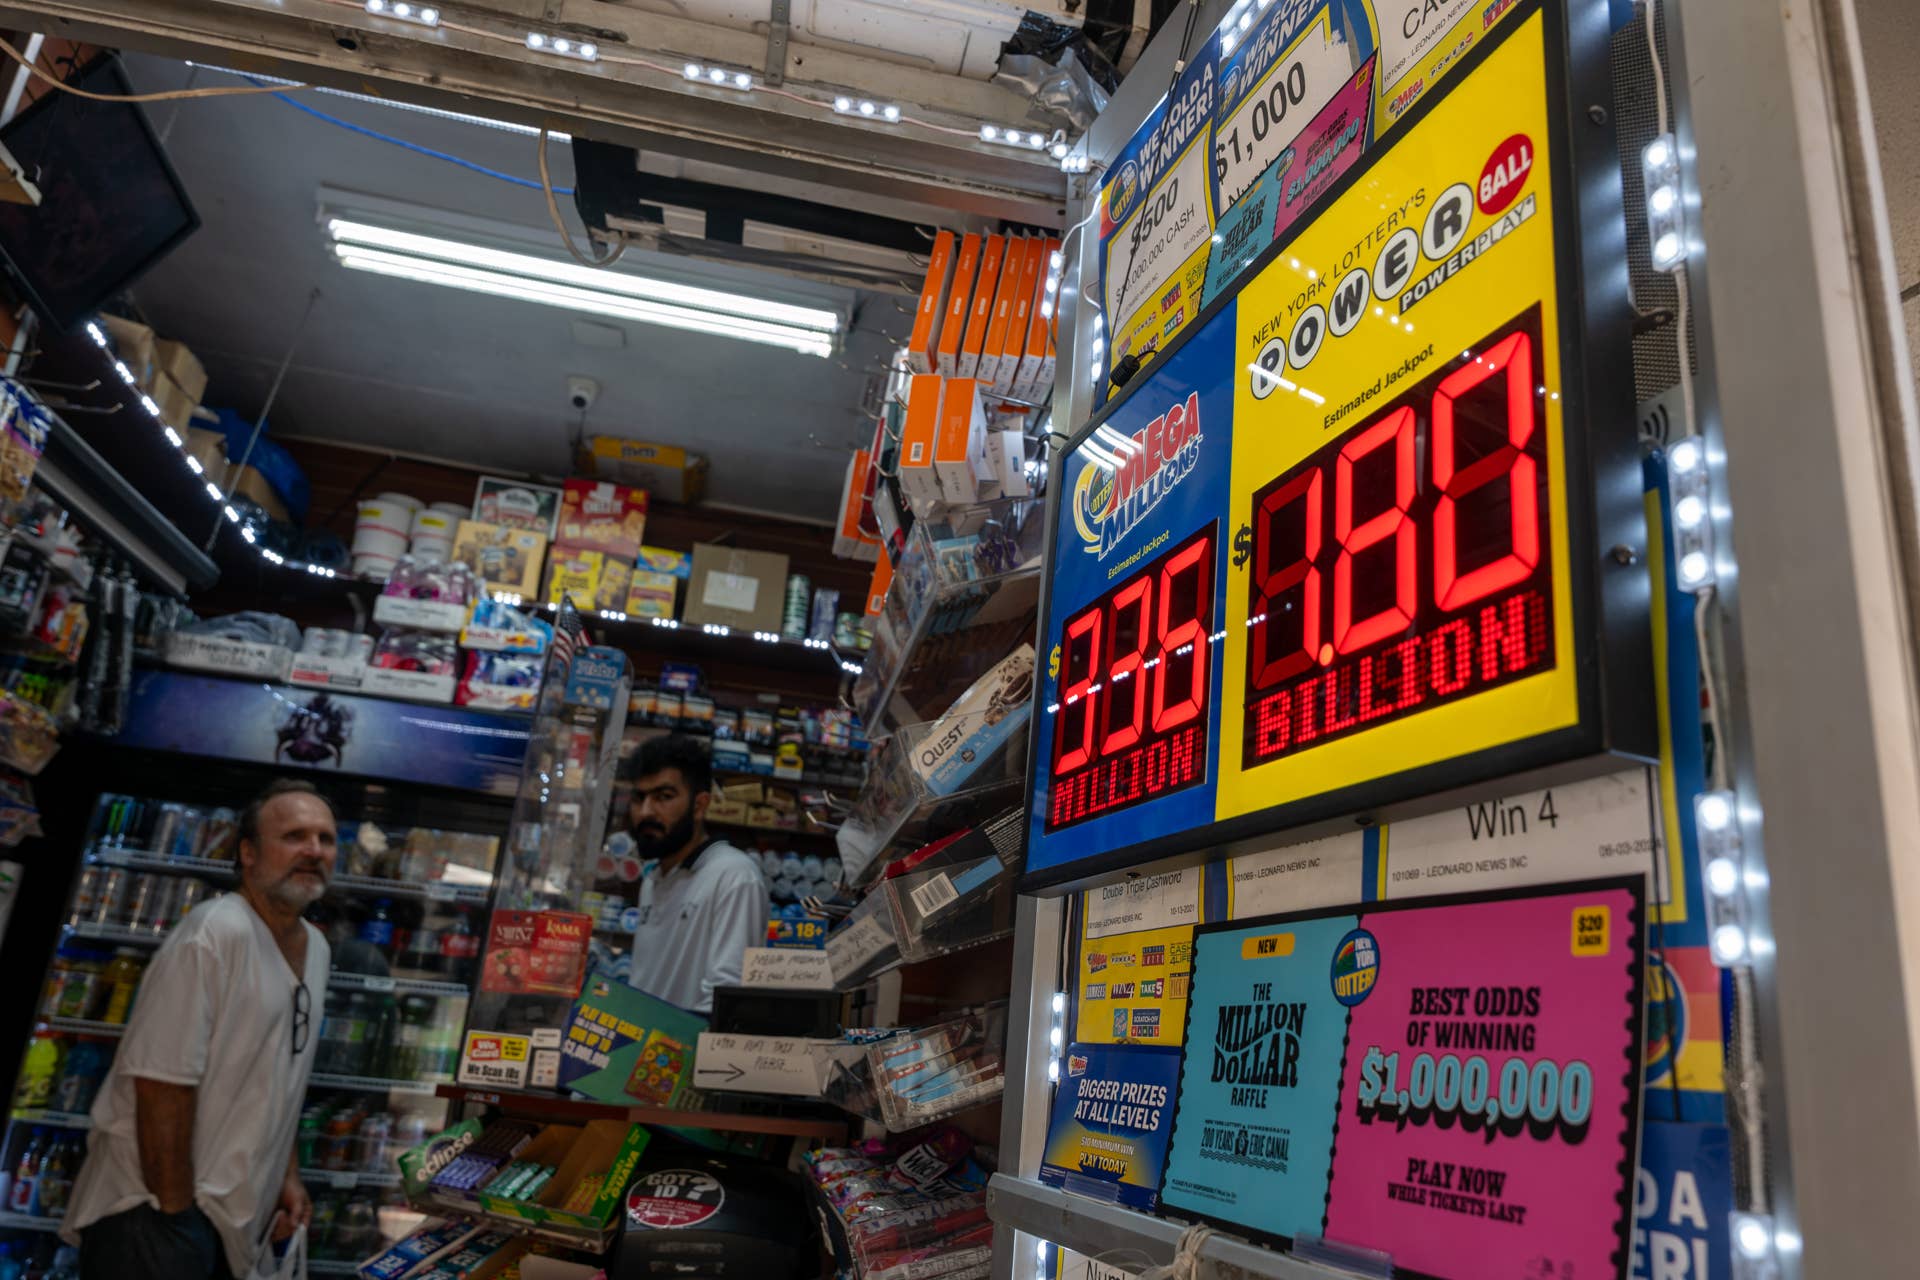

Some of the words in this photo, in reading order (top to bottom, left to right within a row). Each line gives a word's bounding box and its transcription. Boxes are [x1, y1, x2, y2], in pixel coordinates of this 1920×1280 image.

[1245, 25, 1270, 70] WE
[1411, 18, 1446, 56] LEONARD
[1140, 127, 1160, 165] WE
[1203, 62, 1213, 89] A
[1286, 117, 1360, 205] $1,000,000
[1480, 143, 1534, 205] BALL
[1166, 203, 1196, 243] CASH
[1252, 311, 1283, 349] NEW
[1287, 277, 1328, 317] YORK
[1333, 187, 1427, 279] LOTTERY'S
[1257, 192, 1466, 393] POWER
[1323, 379, 1381, 431] Estimated
[1385, 342, 1436, 389] Jackpot
[1105, 390, 1200, 516] MEGA
[1098, 435, 1203, 562] MILLIONS
[1108, 549, 1142, 580] Estimated
[1142, 529, 1170, 558] Jackpot
[1232, 524, 1253, 571] $
[1048, 643, 1061, 681] $
[1251, 594, 1536, 758] BILLION
[921, 725, 964, 767] QUEST
[1050, 727, 1202, 829] MILLION
[1466, 799, 1528, 841] Win
[1537, 789, 1559, 829] 4
[1103, 885, 1124, 901] Double
[1125, 880, 1145, 896] Triple
[1146, 872, 1182, 891] Cashword
[1257, 863, 1286, 880] LEONARD
[1286, 859, 1308, 874] NEWS
[1308, 857, 1320, 869] INC
[1391, 867, 1420, 883] 101069
[1426, 860, 1473, 879] LEONARD
[1474, 857, 1505, 873] NEWS
[1507, 855, 1528, 870] INC
[796, 921, 823, 939] 18+
[1577, 914, 1604, 933] $20
[1257, 938, 1278, 955] NEW
[1354, 936, 1373, 951] NEW
[1355, 951, 1376, 970] YORK
[1141, 983, 1156, 994] TAKE
[1155, 980, 1163, 996] 5
[1253, 982, 1273, 1002] THE
[1409, 987, 1470, 1017] BEST
[1474, 987, 1541, 1017] ODDS
[1215, 1003, 1307, 1052] MILLION
[1406, 1022, 1429, 1048] OF
[1434, 1022, 1536, 1052] WINNING
[467, 1063, 480, 1076] We
[481, 1064, 504, 1079] Scan
[505, 1066, 520, 1080] IDs
[1211, 1032, 1301, 1089] DOLLAR
[1077, 1078, 1120, 1101] BIGGER
[1120, 1082, 1167, 1108] PRIZES
[1230, 1088, 1268, 1109] RAFFLE
[1357, 1046, 1595, 1137] $1,000,000
[1074, 1100, 1090, 1120] AT
[1088, 1102, 1109, 1123] ALL
[1110, 1104, 1160, 1131] LEVELS
[416, 1130, 475, 1182] eclipse
[1091, 1139, 1120, 1153] MINIMUM
[1120, 1143, 1135, 1156] WIN
[1201, 1127, 1215, 1148] 200
[1215, 1129, 1235, 1152] YEARS
[1265, 1135, 1289, 1161] CANAL
[646, 1173, 692, 1187] GOT
[1080, 1152, 1098, 1169] PLAY
[1098, 1156, 1128, 1176] TODAY!
[1406, 1158, 1460, 1190] PLAY
[1461, 1169, 1506, 1198] NOW
[1387, 1182, 1427, 1208] WHILE
[1428, 1188, 1486, 1220] TICKETS
[1487, 1203, 1527, 1225] LAST
